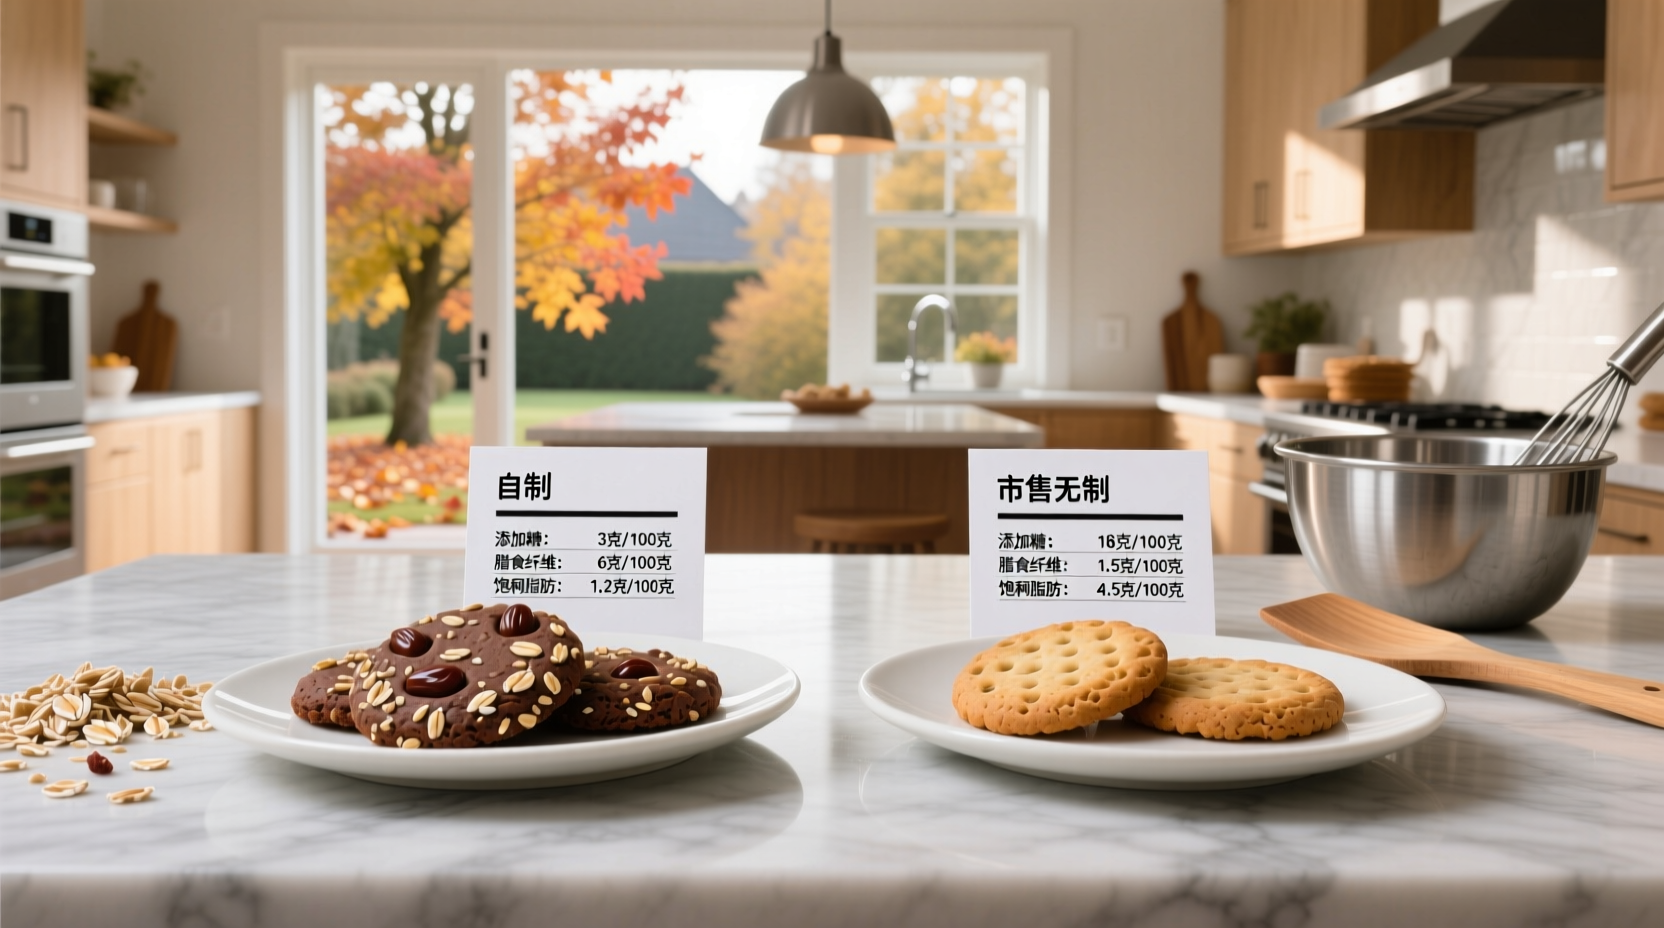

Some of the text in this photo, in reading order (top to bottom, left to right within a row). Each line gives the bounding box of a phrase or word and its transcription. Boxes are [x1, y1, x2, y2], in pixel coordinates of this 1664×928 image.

[498, 472, 552, 501] 自制
[997, 474, 1110, 503] 市售无制
[597, 531, 672, 548] 3克/100克
[1098, 533, 1182, 550] 16克/100克
[597, 554, 672, 571] 6克/100克
[1098, 558, 1183, 574] 1.5克/100克
[590, 578, 675, 595] 1.2克/100克
[1096, 581, 1184, 598] 4.5克/100克
